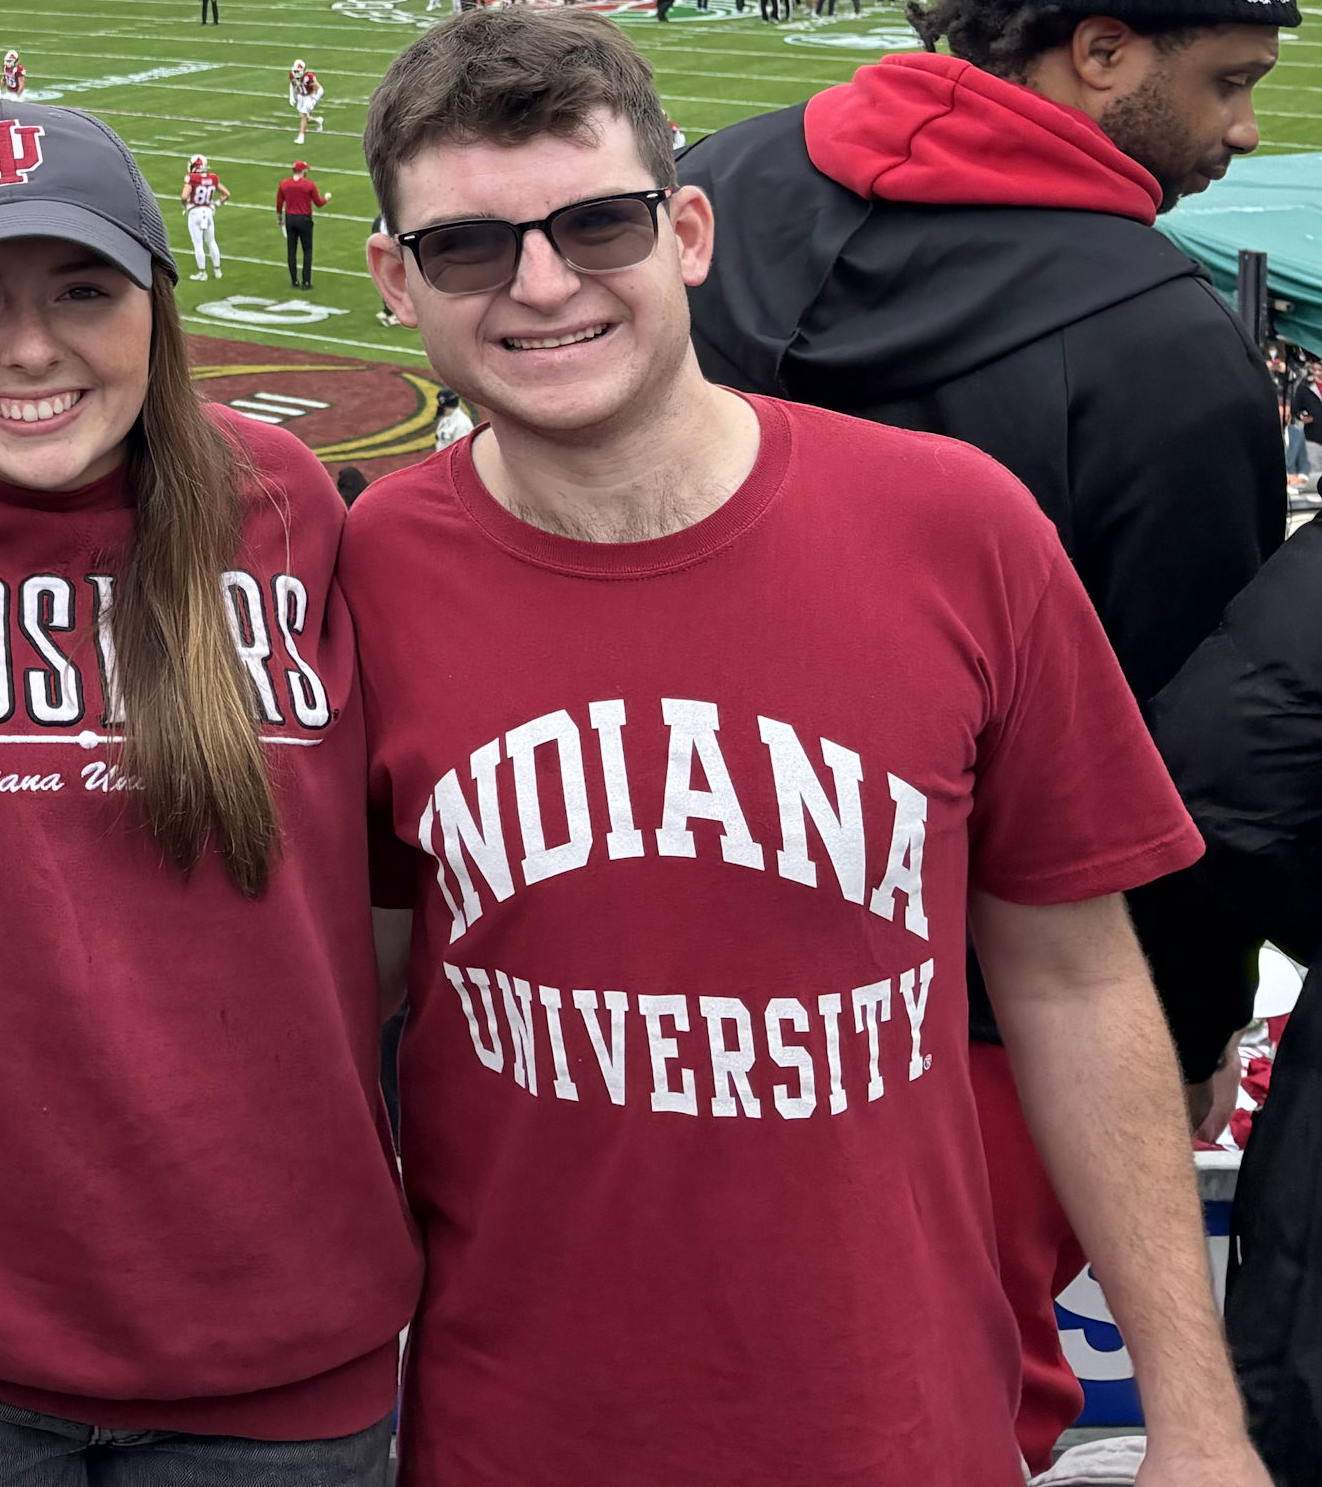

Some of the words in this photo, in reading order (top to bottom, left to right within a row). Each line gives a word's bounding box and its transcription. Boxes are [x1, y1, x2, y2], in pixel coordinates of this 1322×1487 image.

[194, 185, 215, 207] 80
[418, 697, 930, 945] INDIANA
[443, 958, 935, 1120] UNIVERSITY
